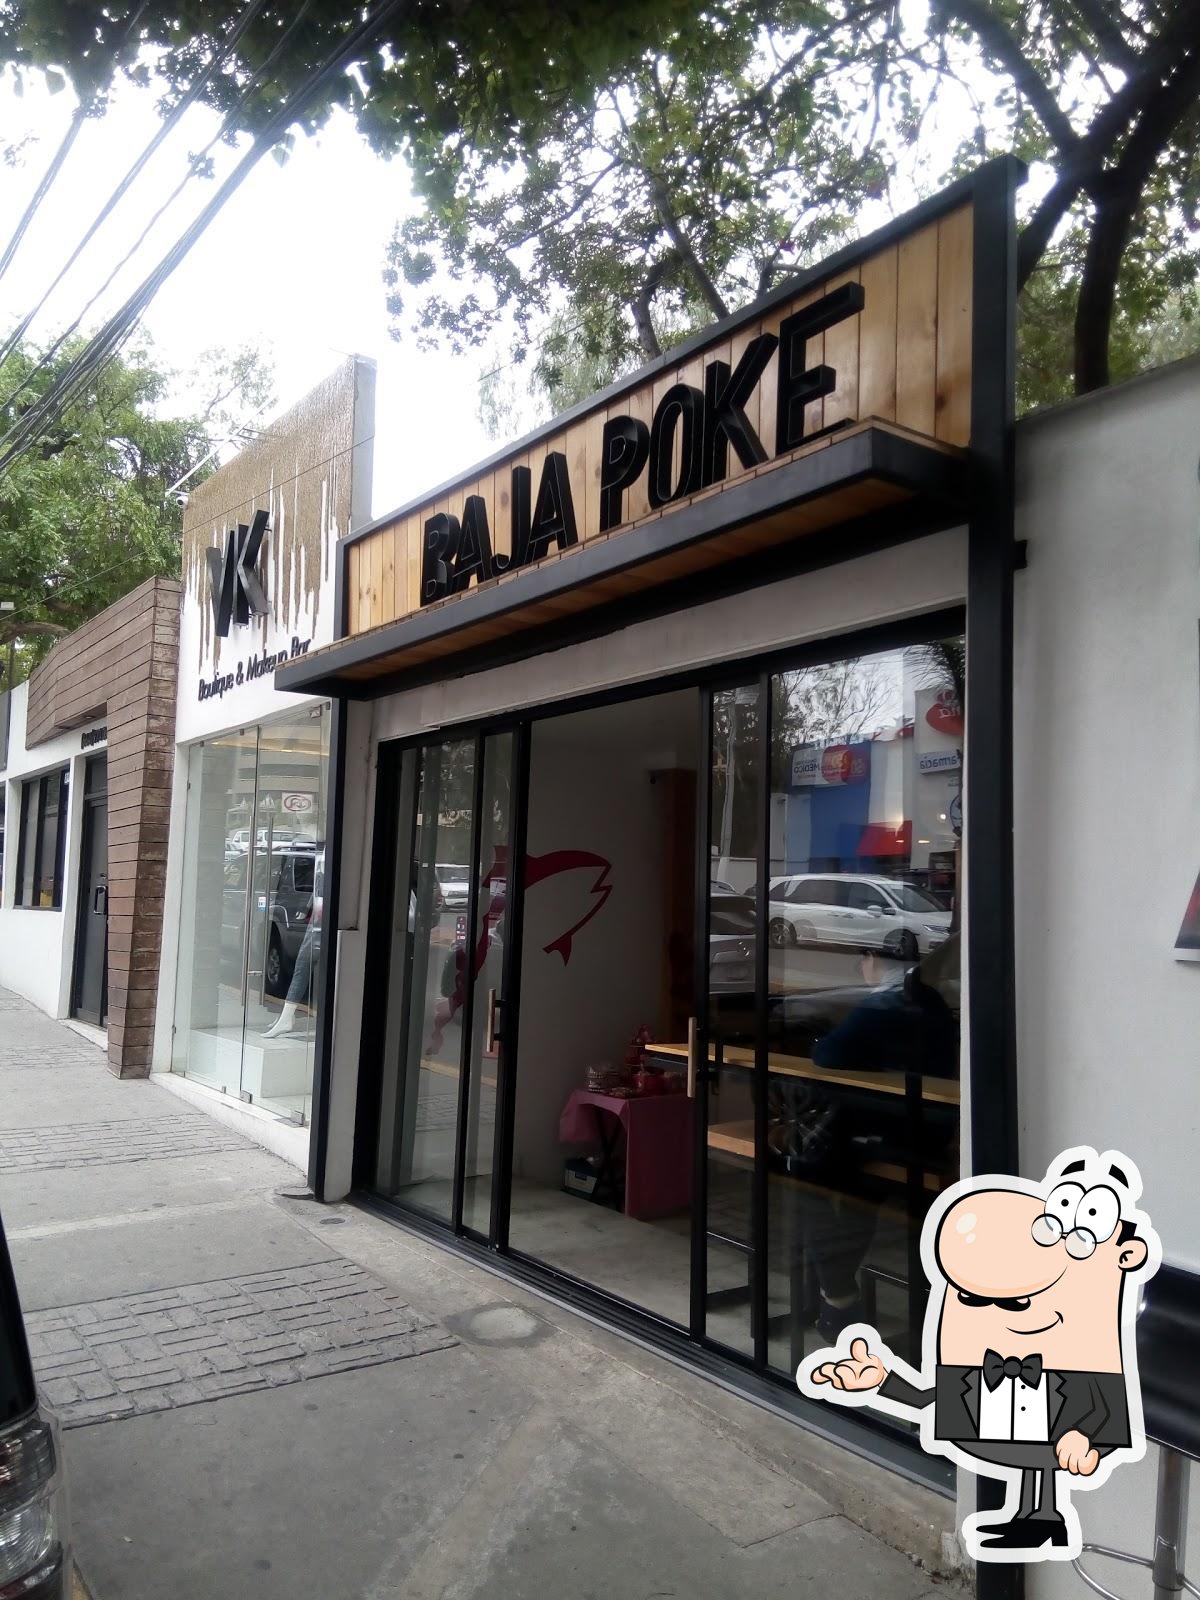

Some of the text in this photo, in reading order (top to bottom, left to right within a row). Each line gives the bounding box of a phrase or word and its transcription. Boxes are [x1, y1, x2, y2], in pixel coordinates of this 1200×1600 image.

[420, 281, 865, 607] BAJA POKE
[206, 509, 270, 637] VK
[198, 671, 234, 702] Boutique
[236, 661, 244, 686] &
